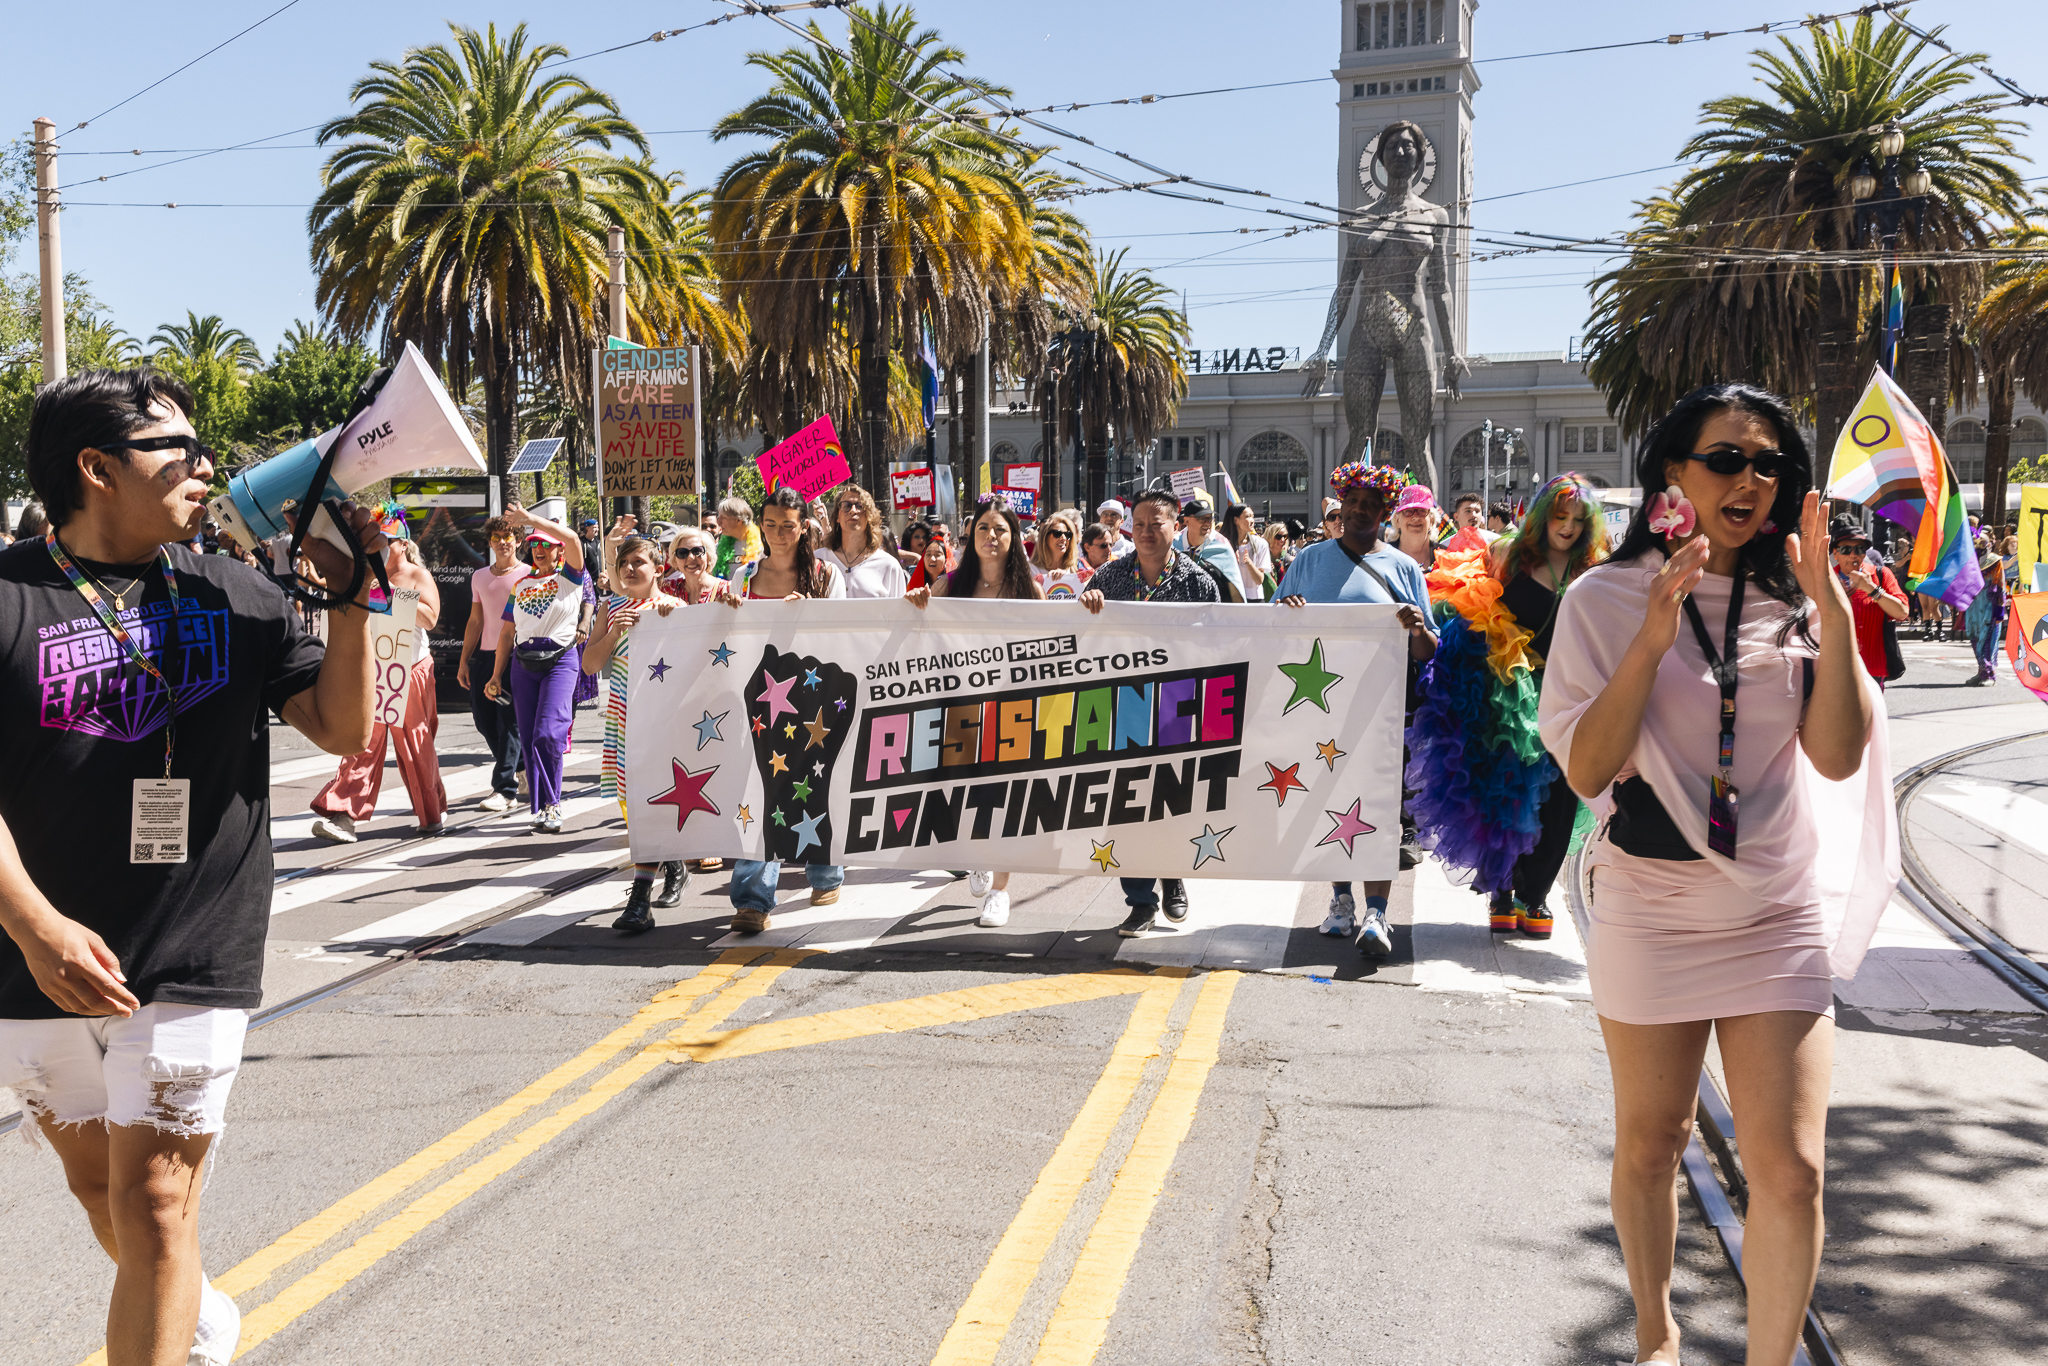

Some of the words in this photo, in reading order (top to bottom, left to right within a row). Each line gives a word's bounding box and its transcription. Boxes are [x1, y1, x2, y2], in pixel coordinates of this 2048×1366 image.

[603, 348, 689, 372] GENDER
[603, 367, 689, 389] AFFIRMING
[617, 384, 674, 405] CARE
[601, 404, 626, 423] AS
[628, 404, 642, 421] A
[647, 403, 694, 420] TEEN
[357, 421, 394, 450] PYLE
[619, 421, 682, 440] SAVED
[604, 440, 636, 458] MY
[641, 439, 685, 457] LIFE
[770, 454, 782, 473] A
[781, 428, 826, 464] GAYER
[604, 458, 638, 475] DON'T
[640, 458, 664, 474] LET
[665, 457, 696, 474] THEM
[782, 448, 827, 484] WORLD
[603, 475, 638, 491] TAKE
[641, 475, 655, 491] IT
[656, 473, 695, 491] AWAY
[799, 468, 839, 498] SSIBLE
[1002, 490, 1033, 500] YASAK
[438, 574, 465, 584] Google
[38, 621, 70, 640] SAN
[71, 605, 149, 632] FRAISCO
[153, 599, 197, 613] PRDE
[49, 616, 209, 675] RESITACE
[375, 628, 413, 661] OF
[866, 661, 901, 681] SAN
[906, 646, 1004, 674] FRANCISCO
[1011, 636, 1074, 661] PRIDE
[870, 675, 961, 702] BOARD
[968, 669, 1002, 688] OF
[1010, 649, 1169, 684] DIRECTORS
[865, 674, 1236, 782] RESISTANCE
[844, 749, 1243, 855] CONTINGENT
